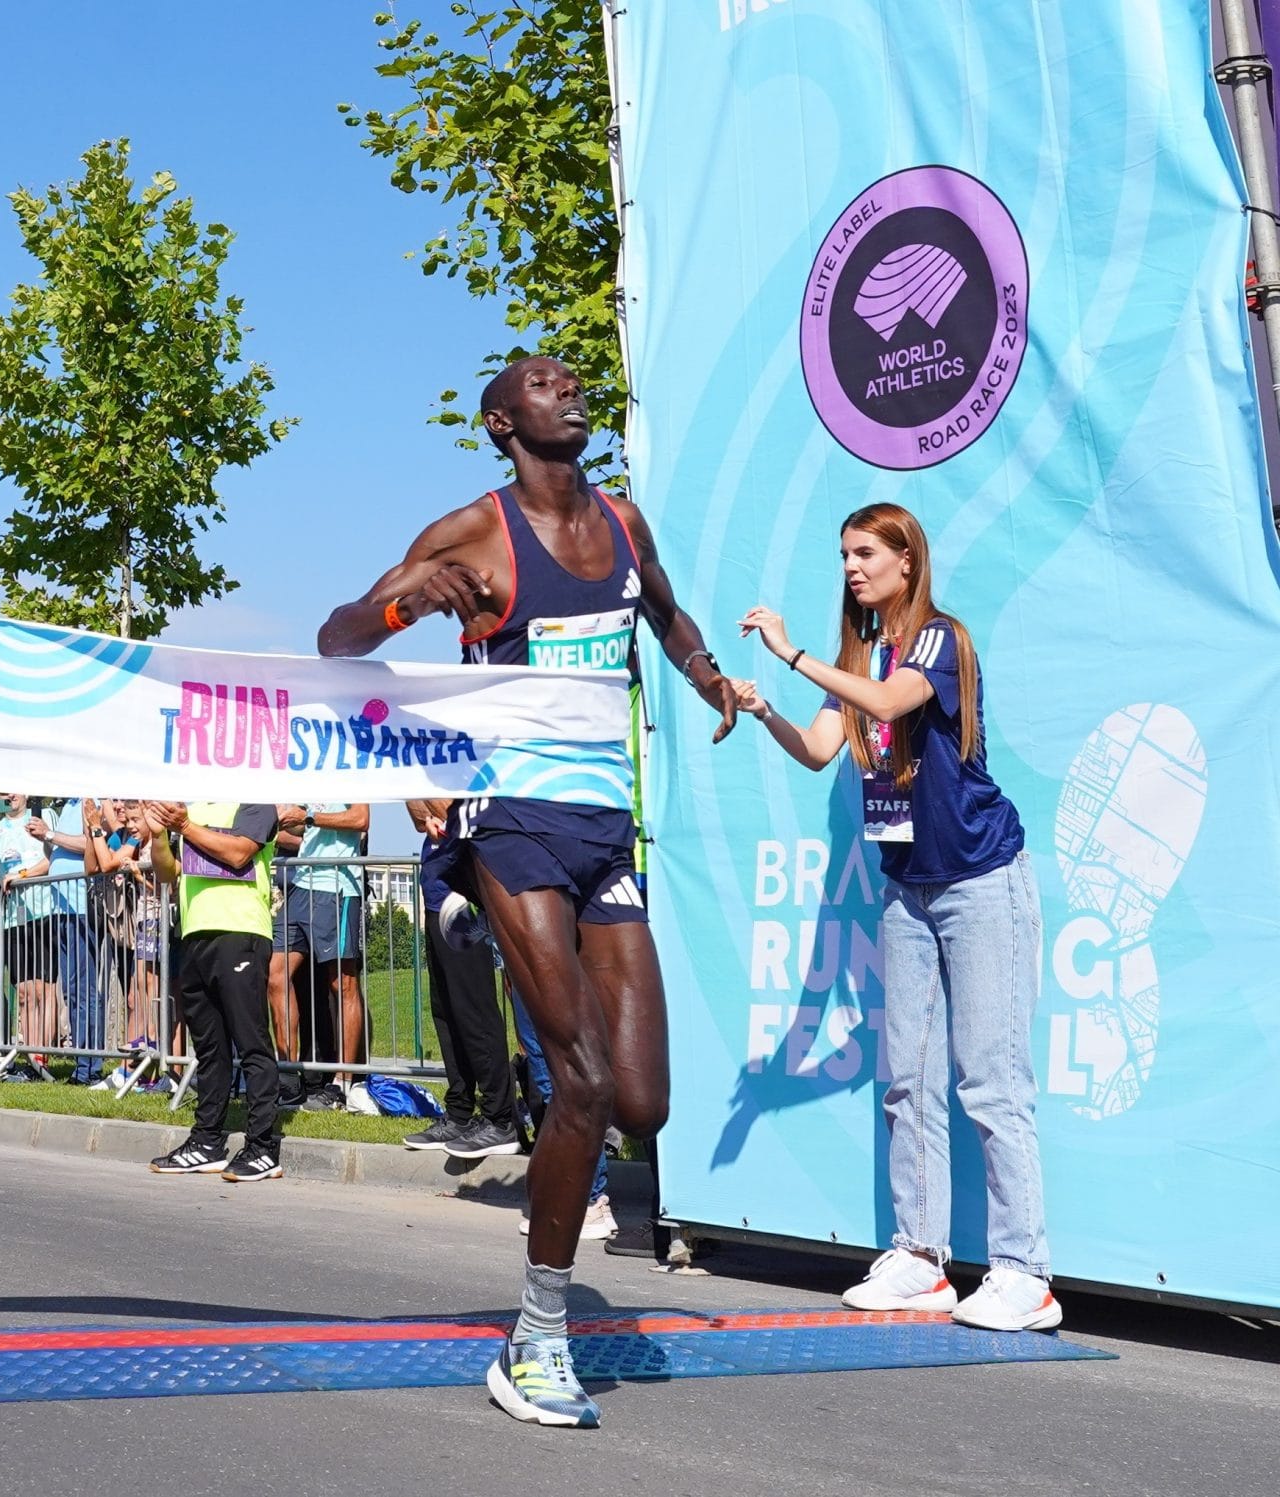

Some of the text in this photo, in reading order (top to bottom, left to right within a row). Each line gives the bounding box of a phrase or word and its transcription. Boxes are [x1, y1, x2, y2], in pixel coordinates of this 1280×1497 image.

[810, 199, 883, 317] ELITE LABEL
[865, 356, 966, 400] ATHLETICS
[878, 338, 947, 373] WORLD
[917, 282, 1017, 454] ROAD RACE 2023
[533, 634, 630, 669] WELDON
[159, 680, 477, 771] TRUNSYLVANIA
[866, 799, 911, 812] STAFF
[750, 916, 1114, 1000] RUNG
[747, 1003, 1088, 1096] FESTL
